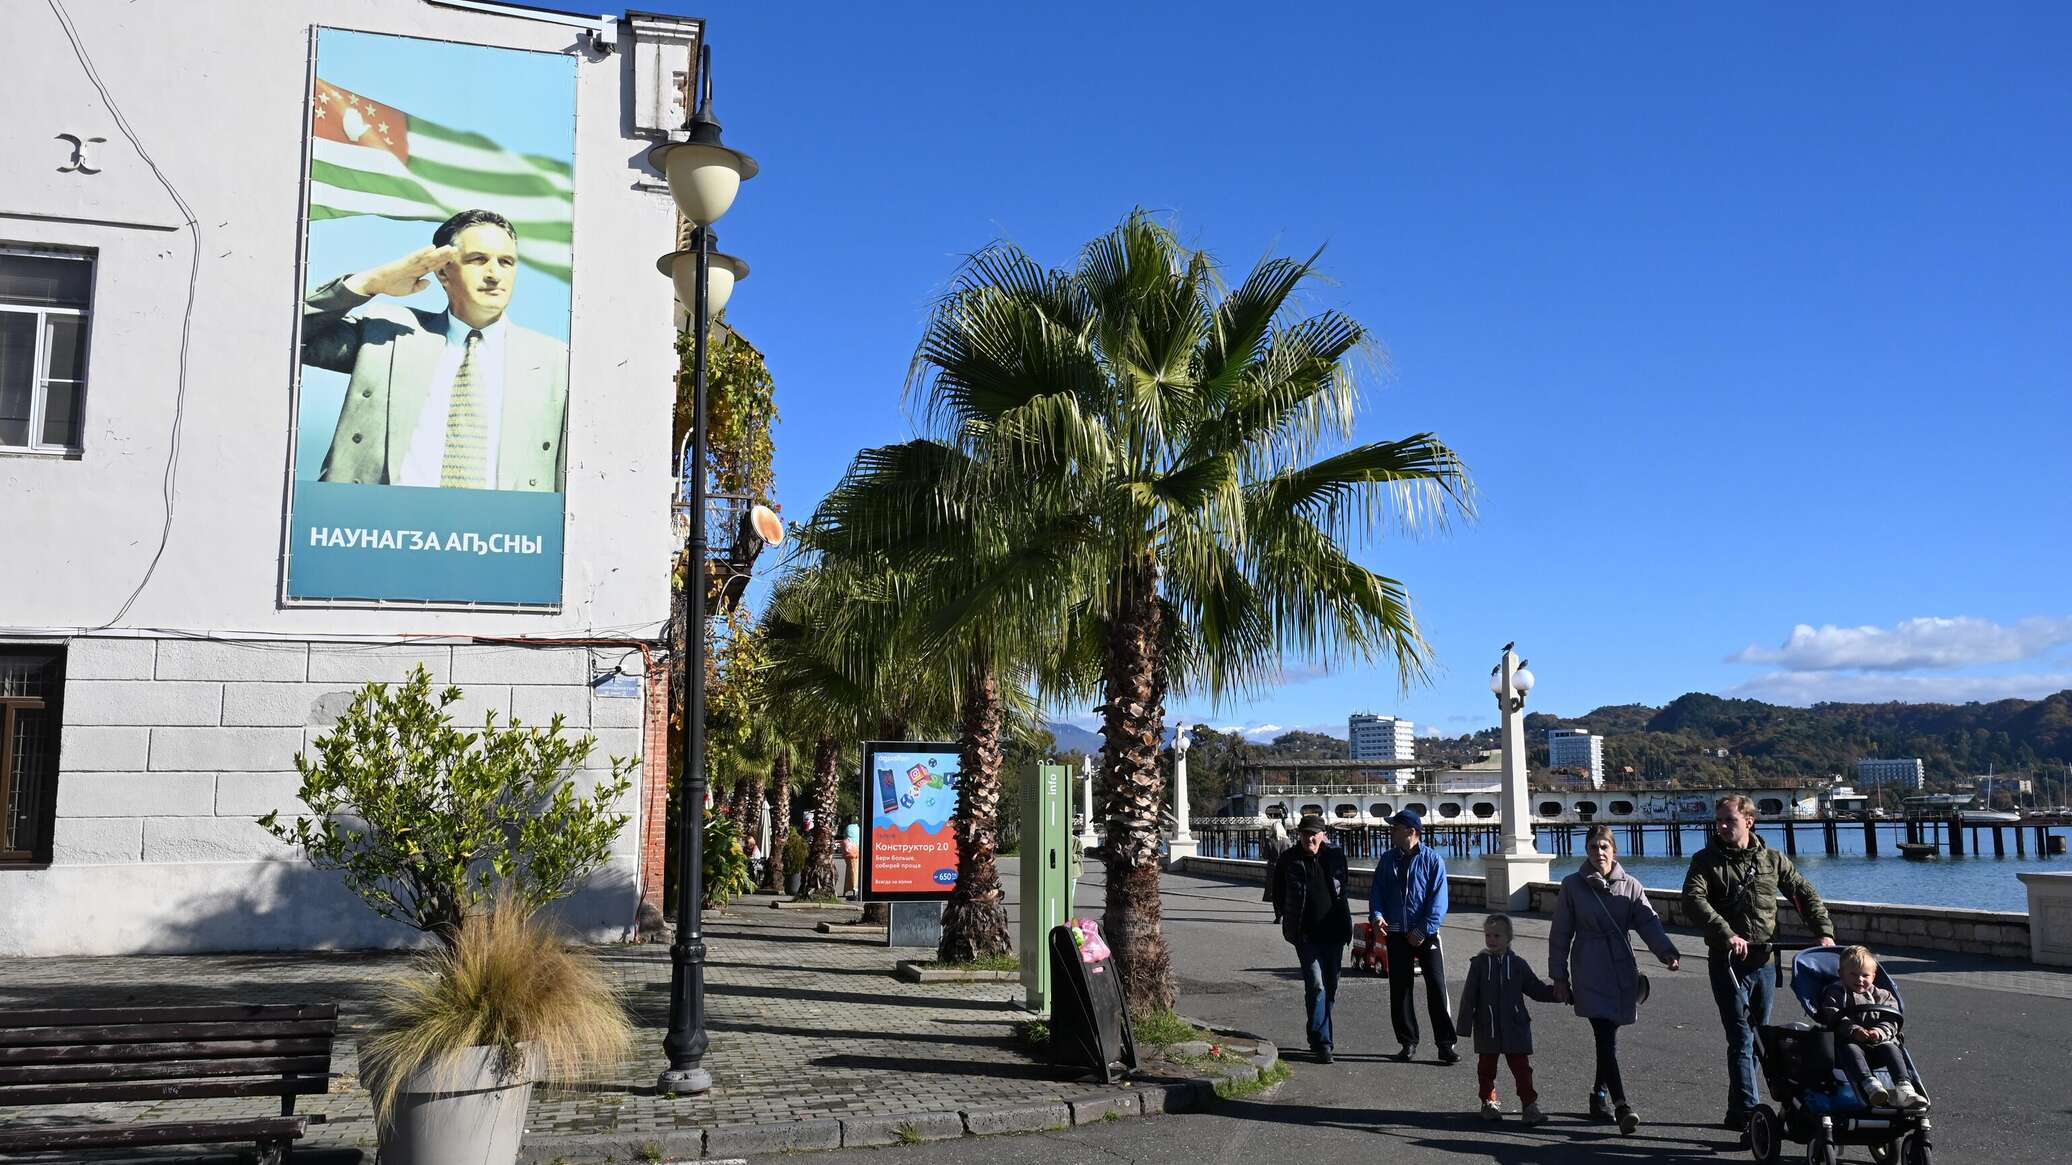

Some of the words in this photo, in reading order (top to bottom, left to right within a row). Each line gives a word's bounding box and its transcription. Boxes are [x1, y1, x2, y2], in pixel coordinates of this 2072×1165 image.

[1048, 774, 1057, 795] info
[875, 842, 935, 853] Конструктор
[937, 842, 949, 852] 2.0
[875, 854, 891, 862] Бери
[939, 873, 951, 881] 650
